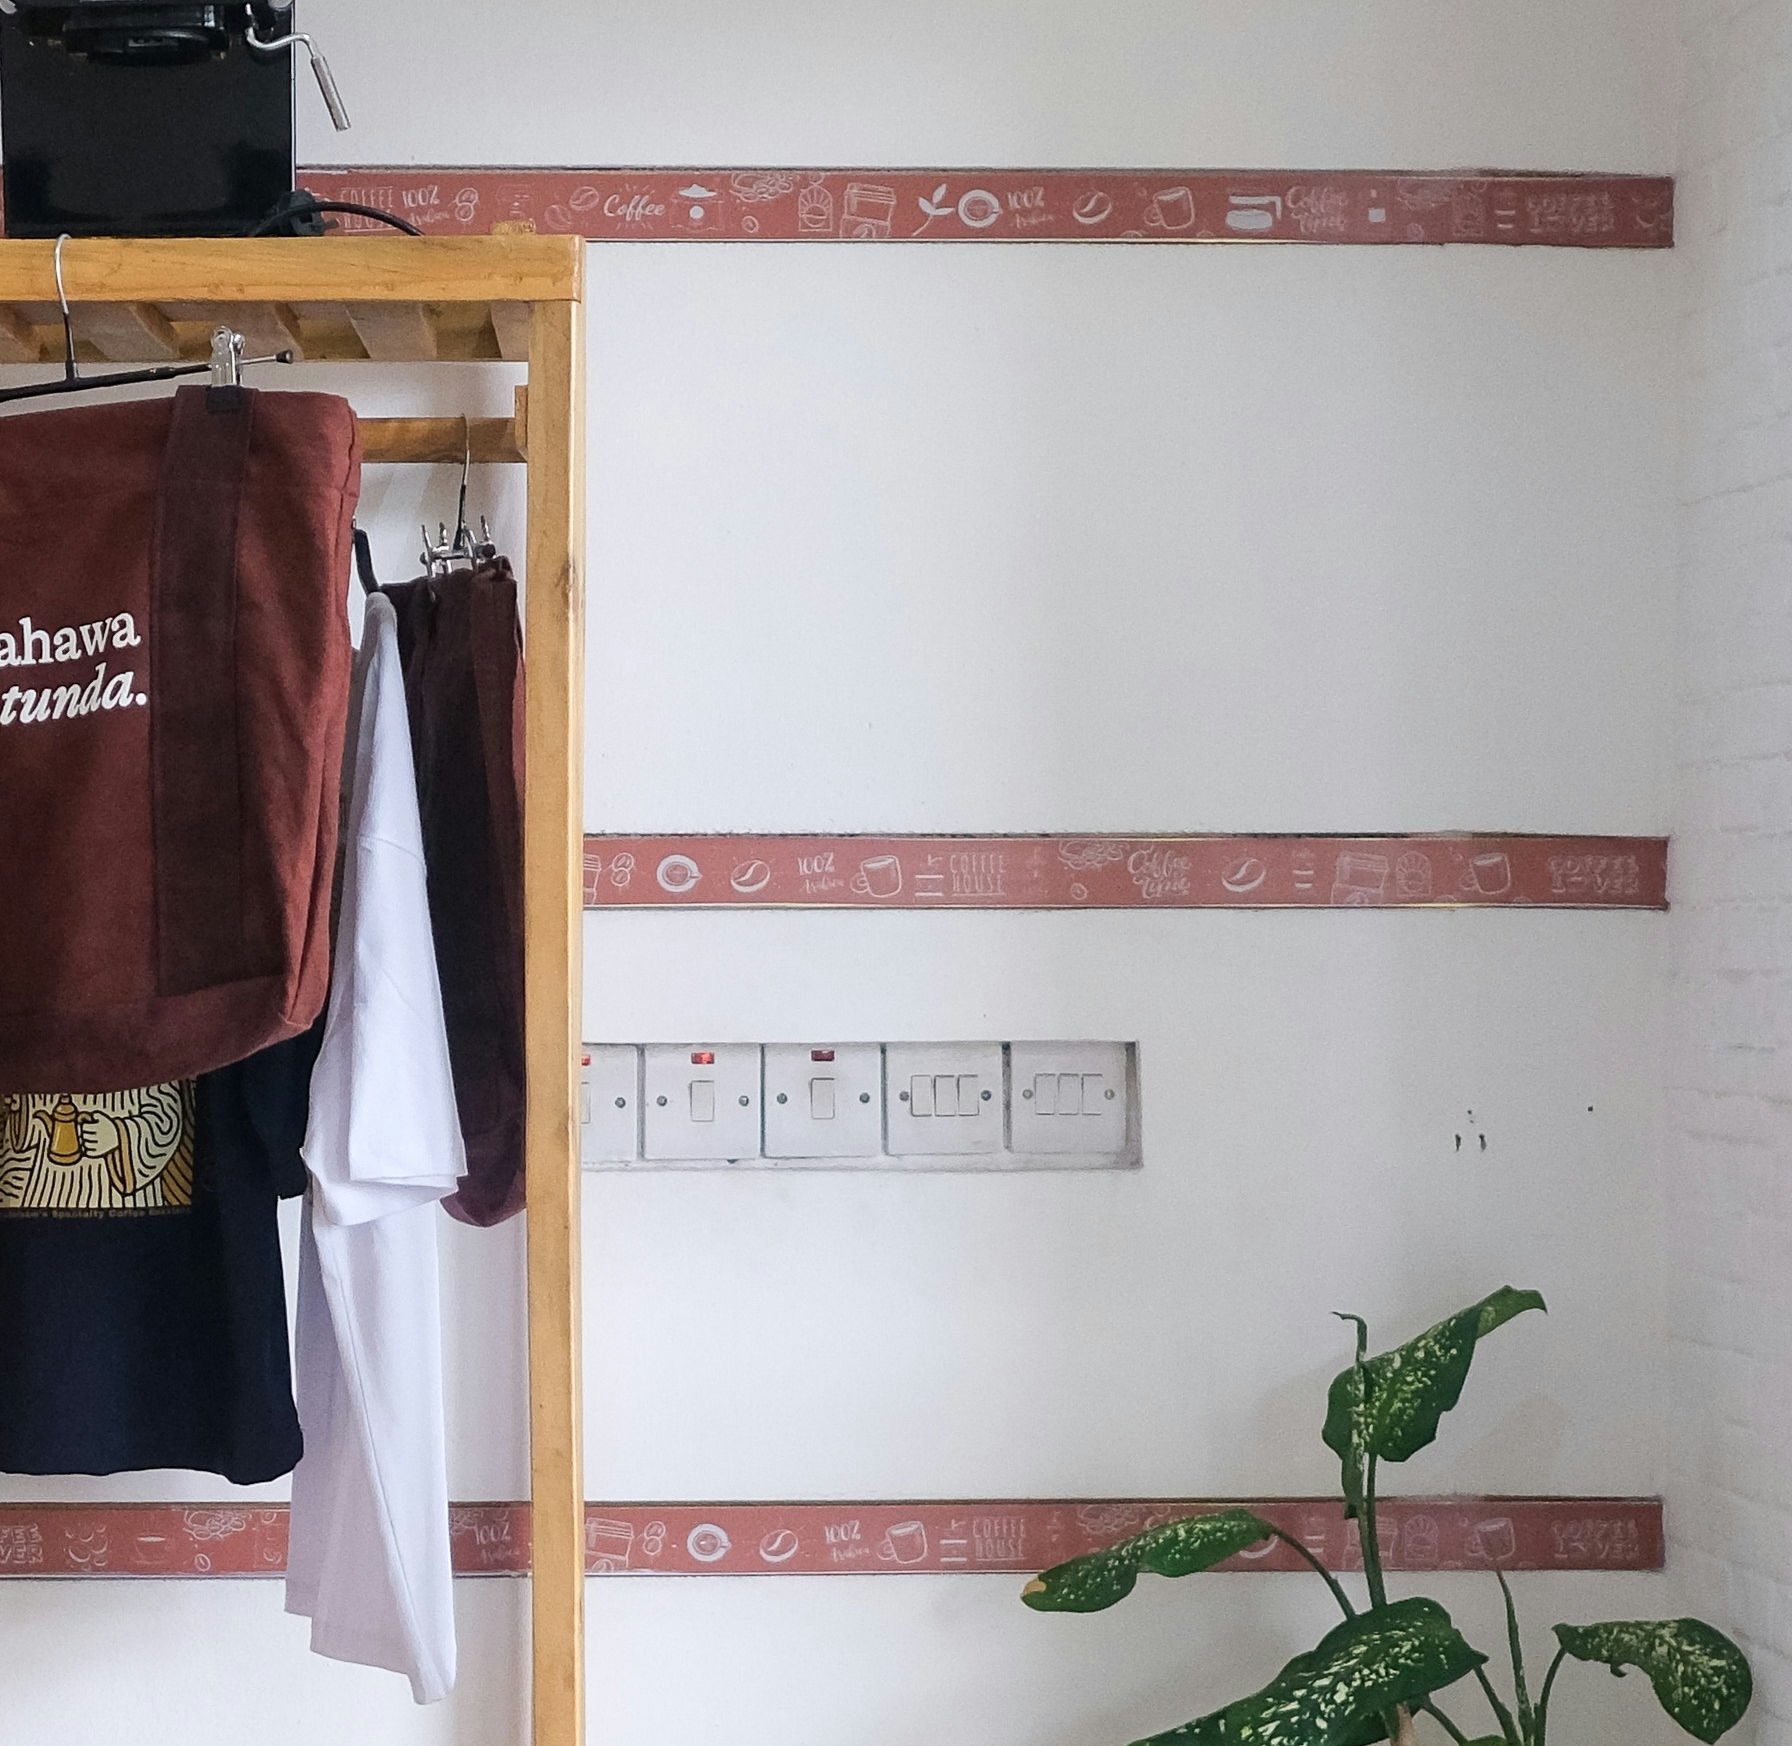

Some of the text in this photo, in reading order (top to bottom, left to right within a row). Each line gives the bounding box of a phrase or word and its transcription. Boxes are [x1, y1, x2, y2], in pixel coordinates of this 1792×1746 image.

[402, 185, 440, 208] 100%
[603, 194, 666, 220] Coffee
[1006, 186, 1045, 209] 100%
[0, 661, 148, 726] tunda.
[797, 852, 835, 876] 100%
[823, 1519, 861, 1544] 100%
[973, 1518, 1027, 1537] COFFEE
